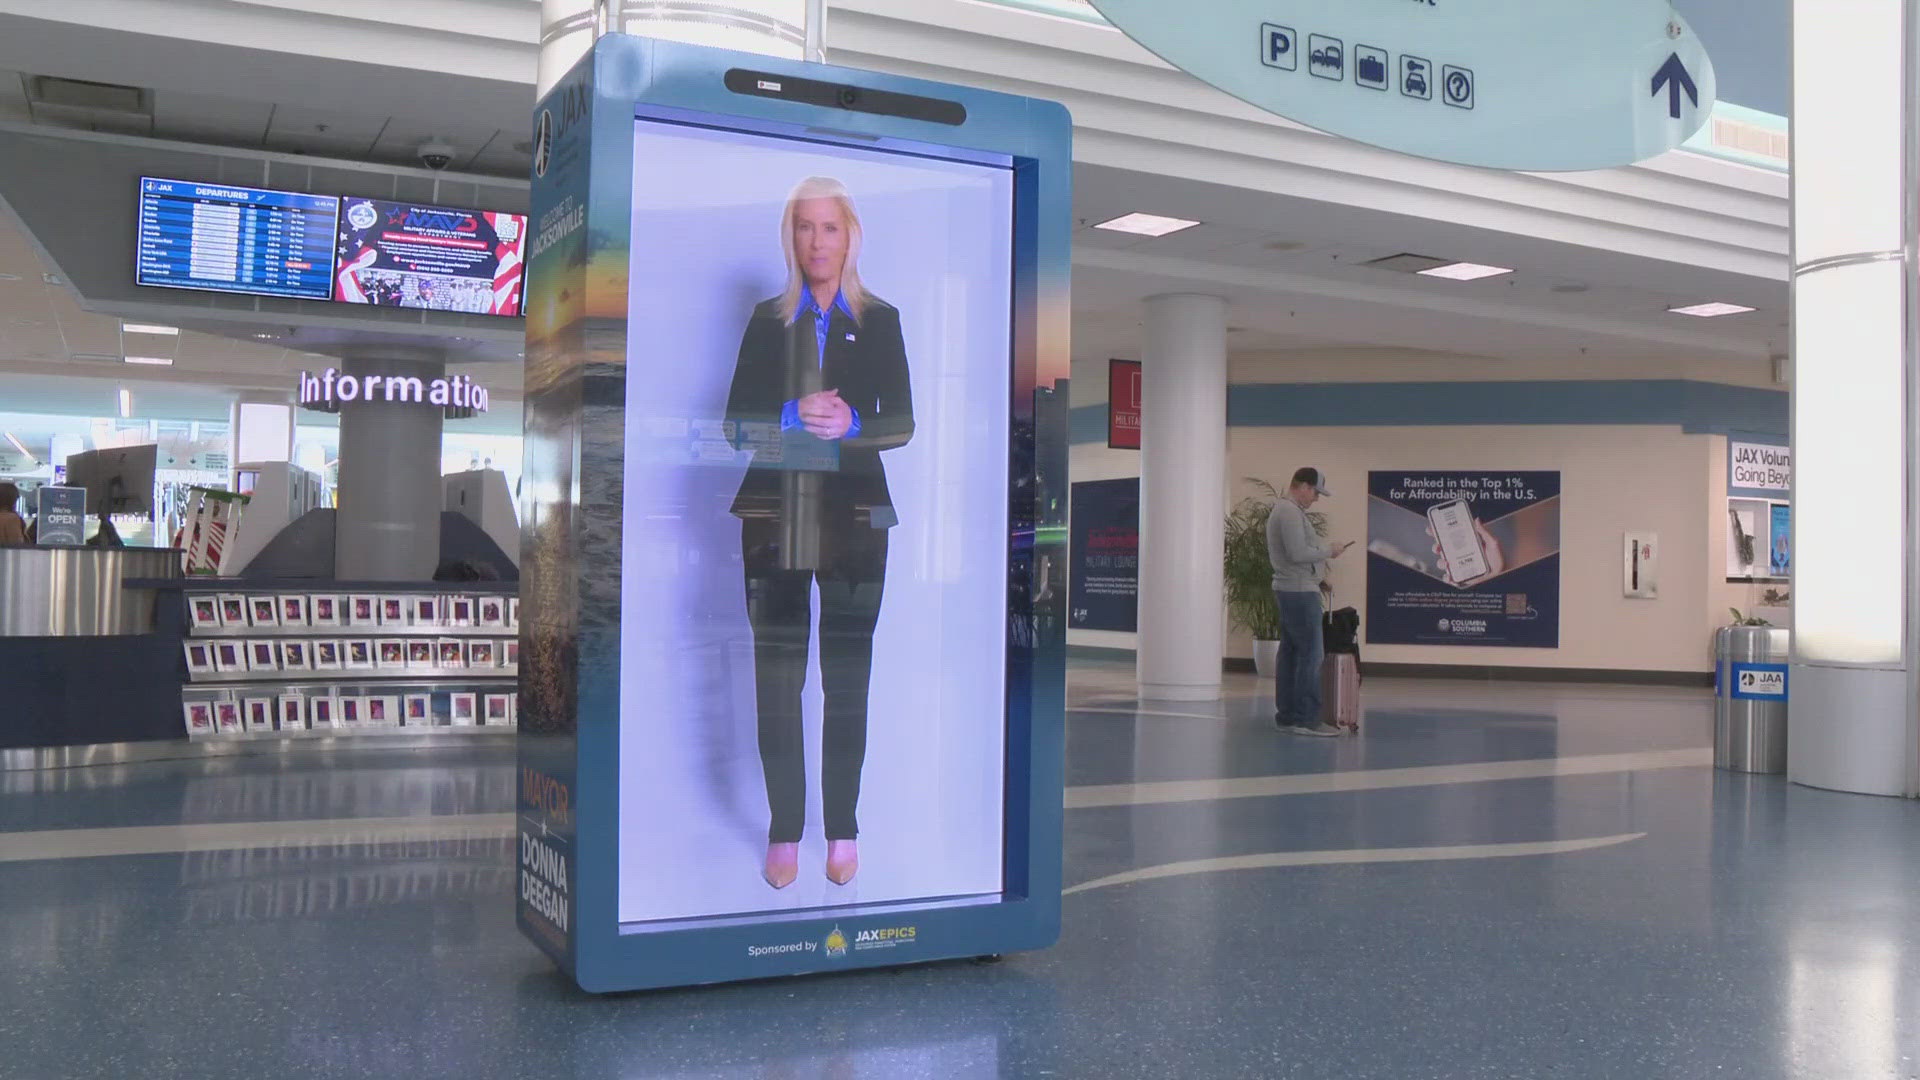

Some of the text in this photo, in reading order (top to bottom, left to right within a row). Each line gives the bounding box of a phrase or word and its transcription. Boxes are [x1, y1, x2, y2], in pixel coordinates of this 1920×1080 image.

[558, 80, 588, 138] JAX
[158, 184, 173, 192] JAX
[195, 187, 249, 200] DEPARTURES
[540, 195, 573, 231] WELCOME TO
[403, 225, 425, 233] MILITARY
[531, 204, 584, 259] JACKSONVILLE
[301, 367, 489, 413] Information
[1115, 415, 1140, 426] MILITA
[1735, 448, 1758, 465] JAX
[1403, 477, 1523, 491] Ranked in the Top 1%
[1735, 466, 1766, 487] Going
[1390, 489, 1537, 502] for Affordability in the U.S.
[52, 506, 72, 514] We're
[47, 514, 77, 524] OPEN
[1451, 619, 1487, 627] COLUMBIA
[1759, 673, 1782, 683] JAA
[522, 767, 569, 825] MAYOR
[522, 831, 568, 893] DONNA
[522, 869, 568, 932] DEEGAN
[748, 927, 916, 957] Sponsored by JAXEPICS
